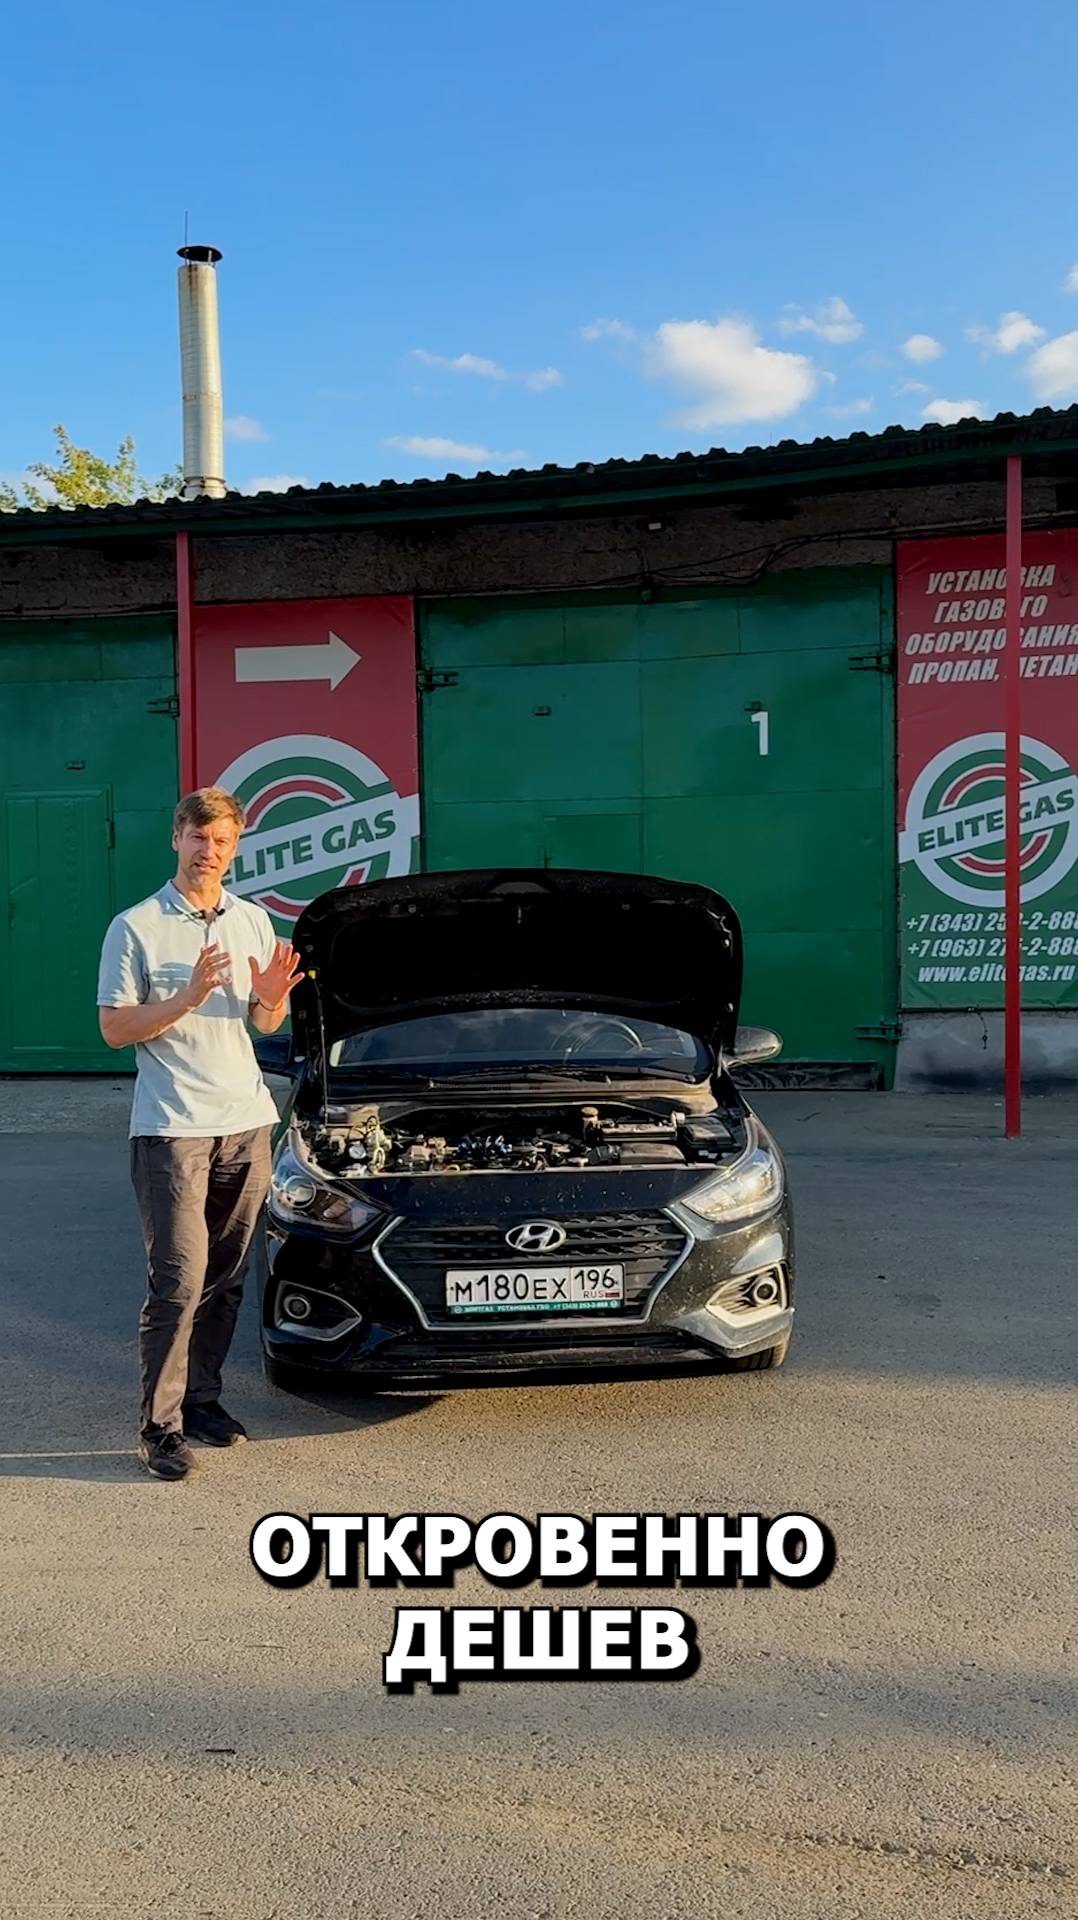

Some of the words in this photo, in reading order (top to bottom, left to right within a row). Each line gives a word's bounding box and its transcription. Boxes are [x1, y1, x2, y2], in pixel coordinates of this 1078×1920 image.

[933, 595, 1048, 623] ГАЗОВГО
[904, 623, 1078, 655] ОБОРУДОАНИЯ
[908, 658, 1000, 684] ПРОПАН,
[751, 711, 768, 755] 1
[321, 809, 396, 854] GAS
[917, 808, 1004, 853] ELITE
[455, 1273, 567, 1301] М180ЕХ
[574, 1268, 615, 1290] 196
